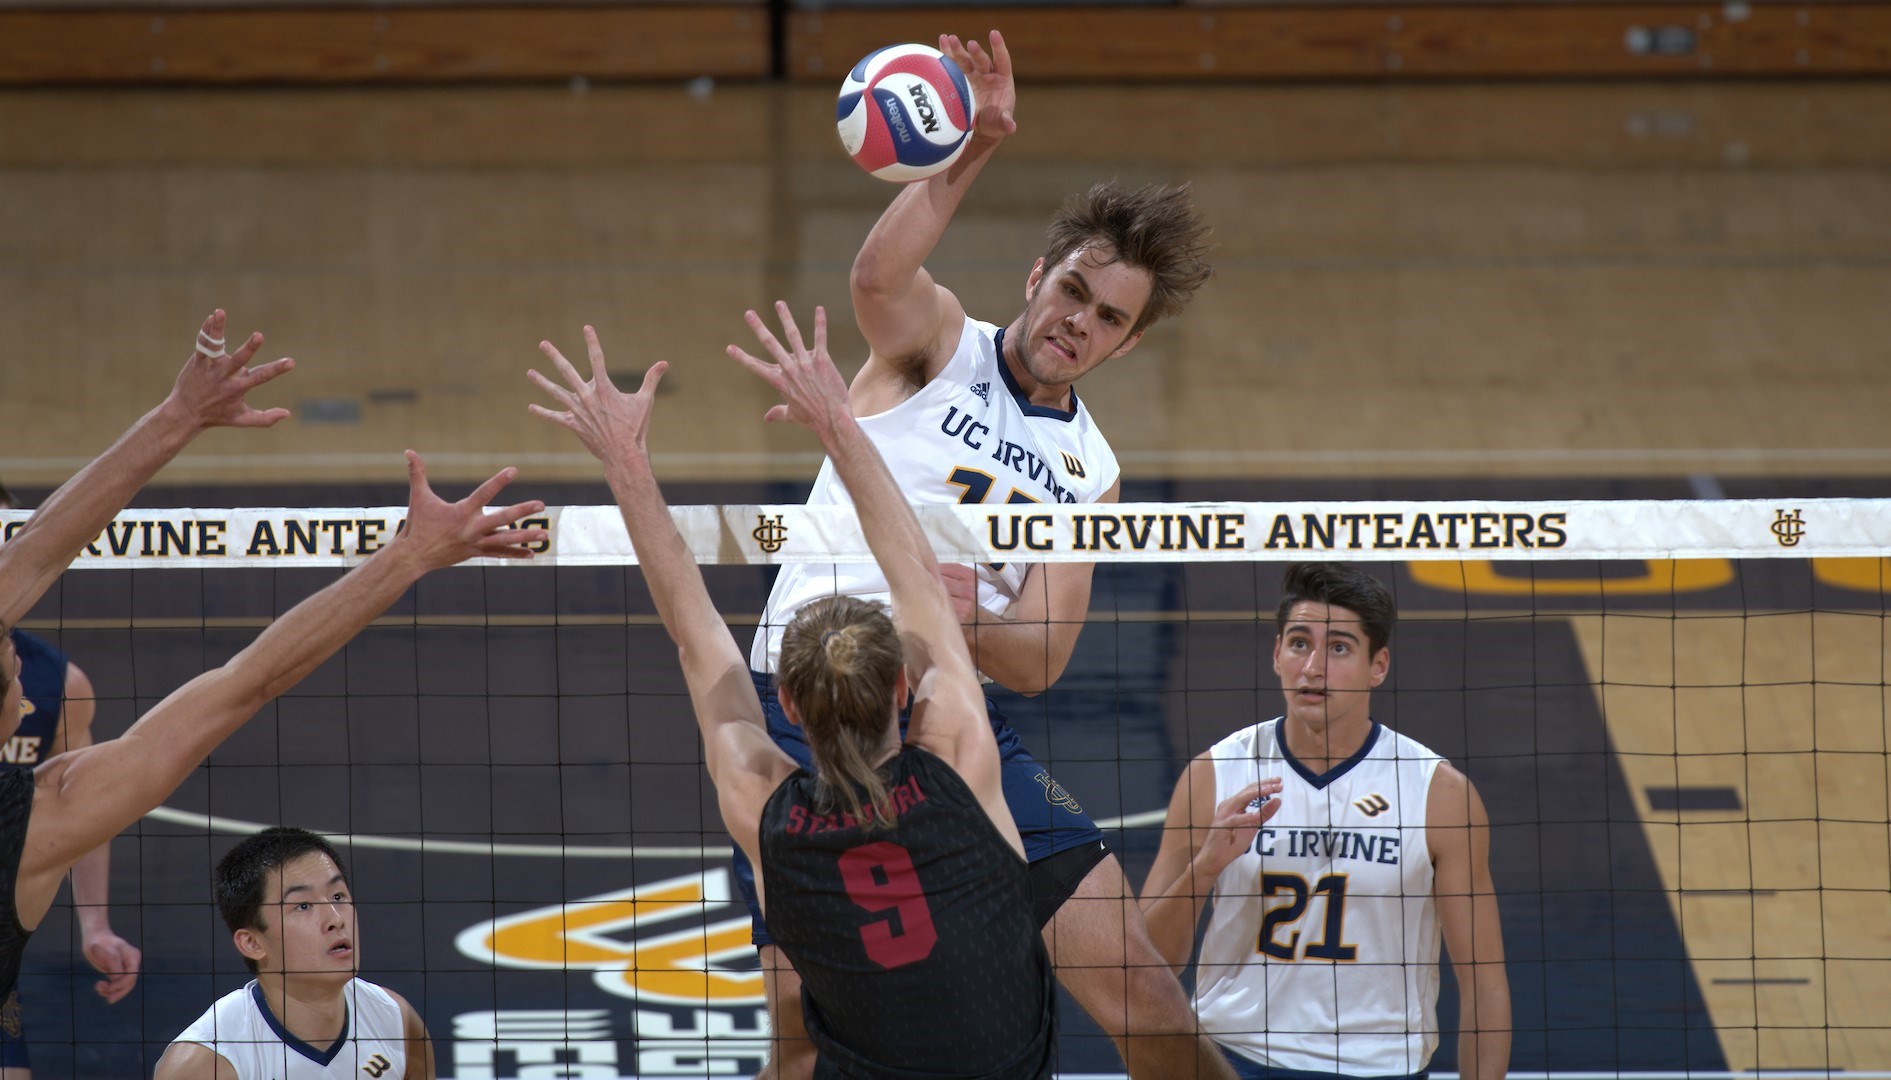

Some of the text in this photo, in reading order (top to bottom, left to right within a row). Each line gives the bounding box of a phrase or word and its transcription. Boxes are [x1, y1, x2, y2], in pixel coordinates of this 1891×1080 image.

[886, 97, 911, 143] molten
[909, 84, 940, 134] NCAA
[941, 406, 989, 450] UC
[77, 520, 227, 557] VINE
[986, 513, 1568, 551] UC IRVINE ANTEATERS
[1288, 830, 1400, 865] IRVINE
[838, 841, 938, 970] 9
[1256, 871, 1358, 962] 21
